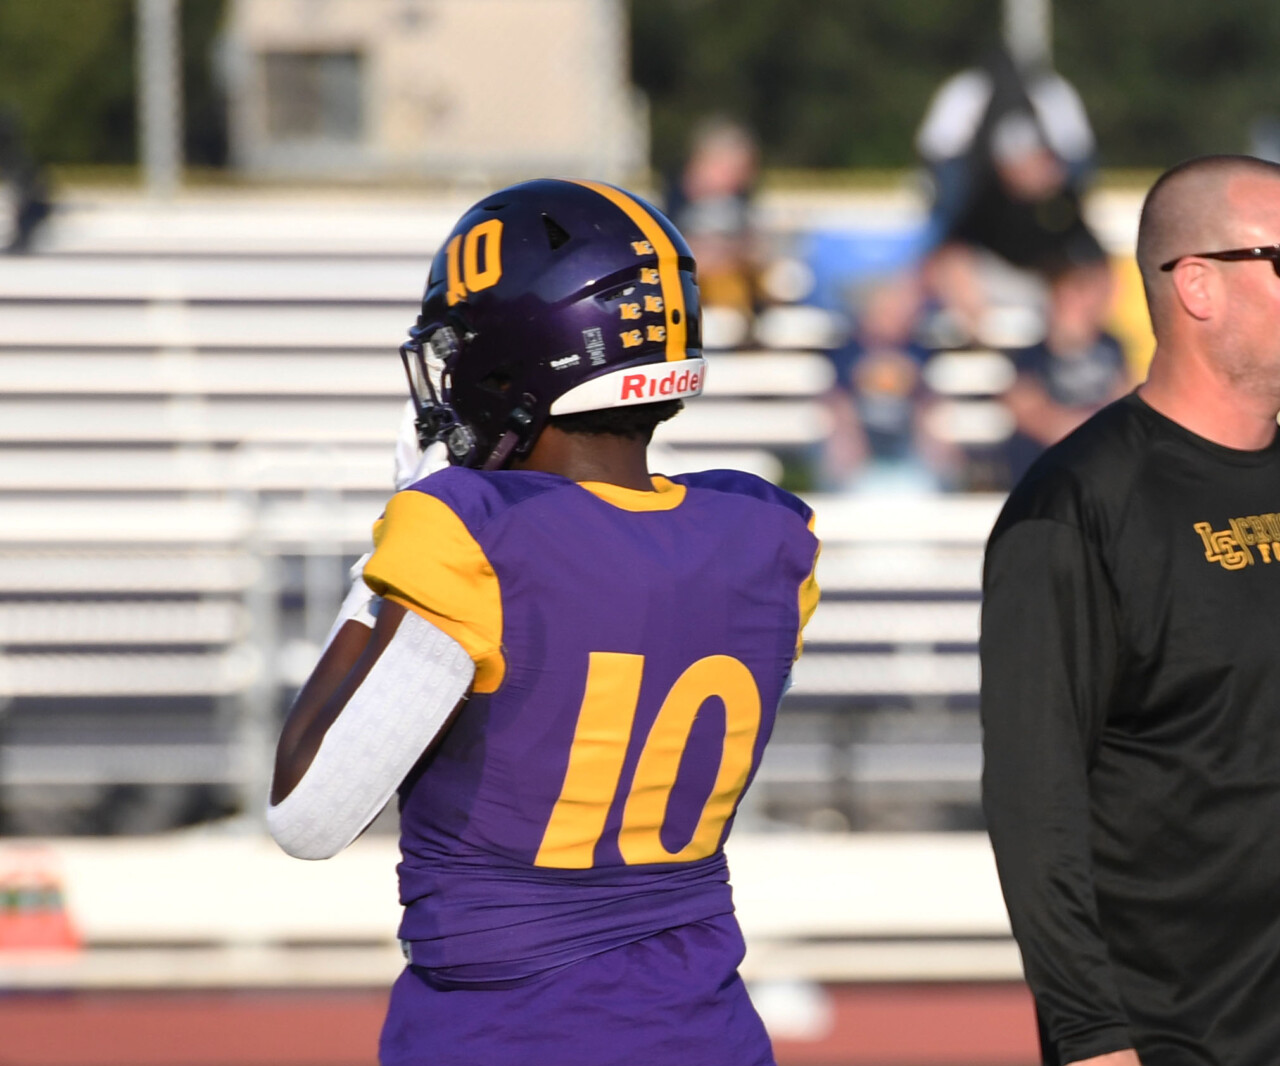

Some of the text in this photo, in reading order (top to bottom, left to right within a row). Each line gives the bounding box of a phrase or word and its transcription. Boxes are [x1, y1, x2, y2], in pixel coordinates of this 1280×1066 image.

[445, 218, 504, 307] 10
[621, 366, 706, 400] Riddel
[534, 652, 761, 869] 10
